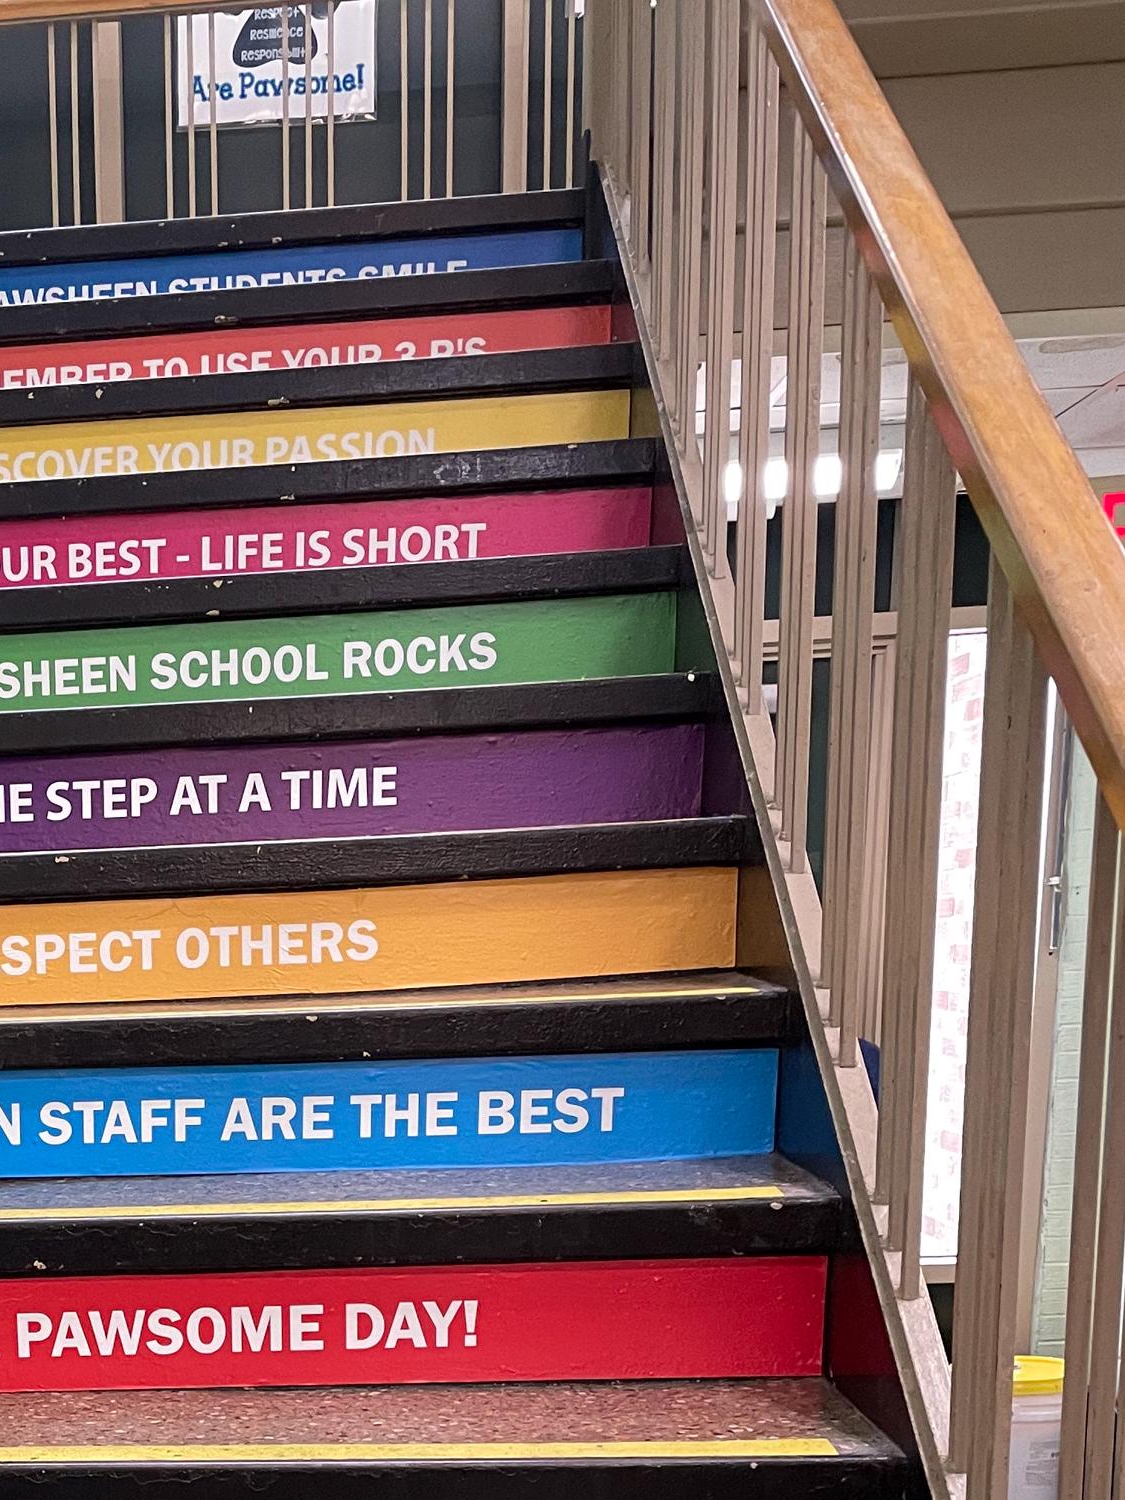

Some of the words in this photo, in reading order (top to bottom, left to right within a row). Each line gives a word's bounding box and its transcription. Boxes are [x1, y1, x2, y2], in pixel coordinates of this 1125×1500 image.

[250, 26, 304, 41] Resiliece
[239, 63, 365, 99] Pawsome!
[147, 439, 255, 473] YOUR
[266, 427, 436, 464] PASSION
[69, 539, 166, 578] BEST
[202, 533, 283, 571] LIFE
[296, 531, 331, 567] IS
[343, 522, 487, 564] SHORT
[149, 642, 330, 692] SCHOOL
[343, 632, 497, 680] ROCKS
[47, 778, 157, 820] STEP
[170, 775, 227, 815] AT
[239, 773, 271, 812] A
[281, 767, 397, 809] TIME
[176, 920, 378, 968] OTHERS
[39, 1099, 205, 1144] STAFF
[221, 1096, 334, 1140] ARE
[350, 1092, 458, 1137] THE
[478, 1088, 624, 1134] BEST
[17, 1305, 323, 1357] PAWSOME
[346, 1300, 477, 1349] DAY!
